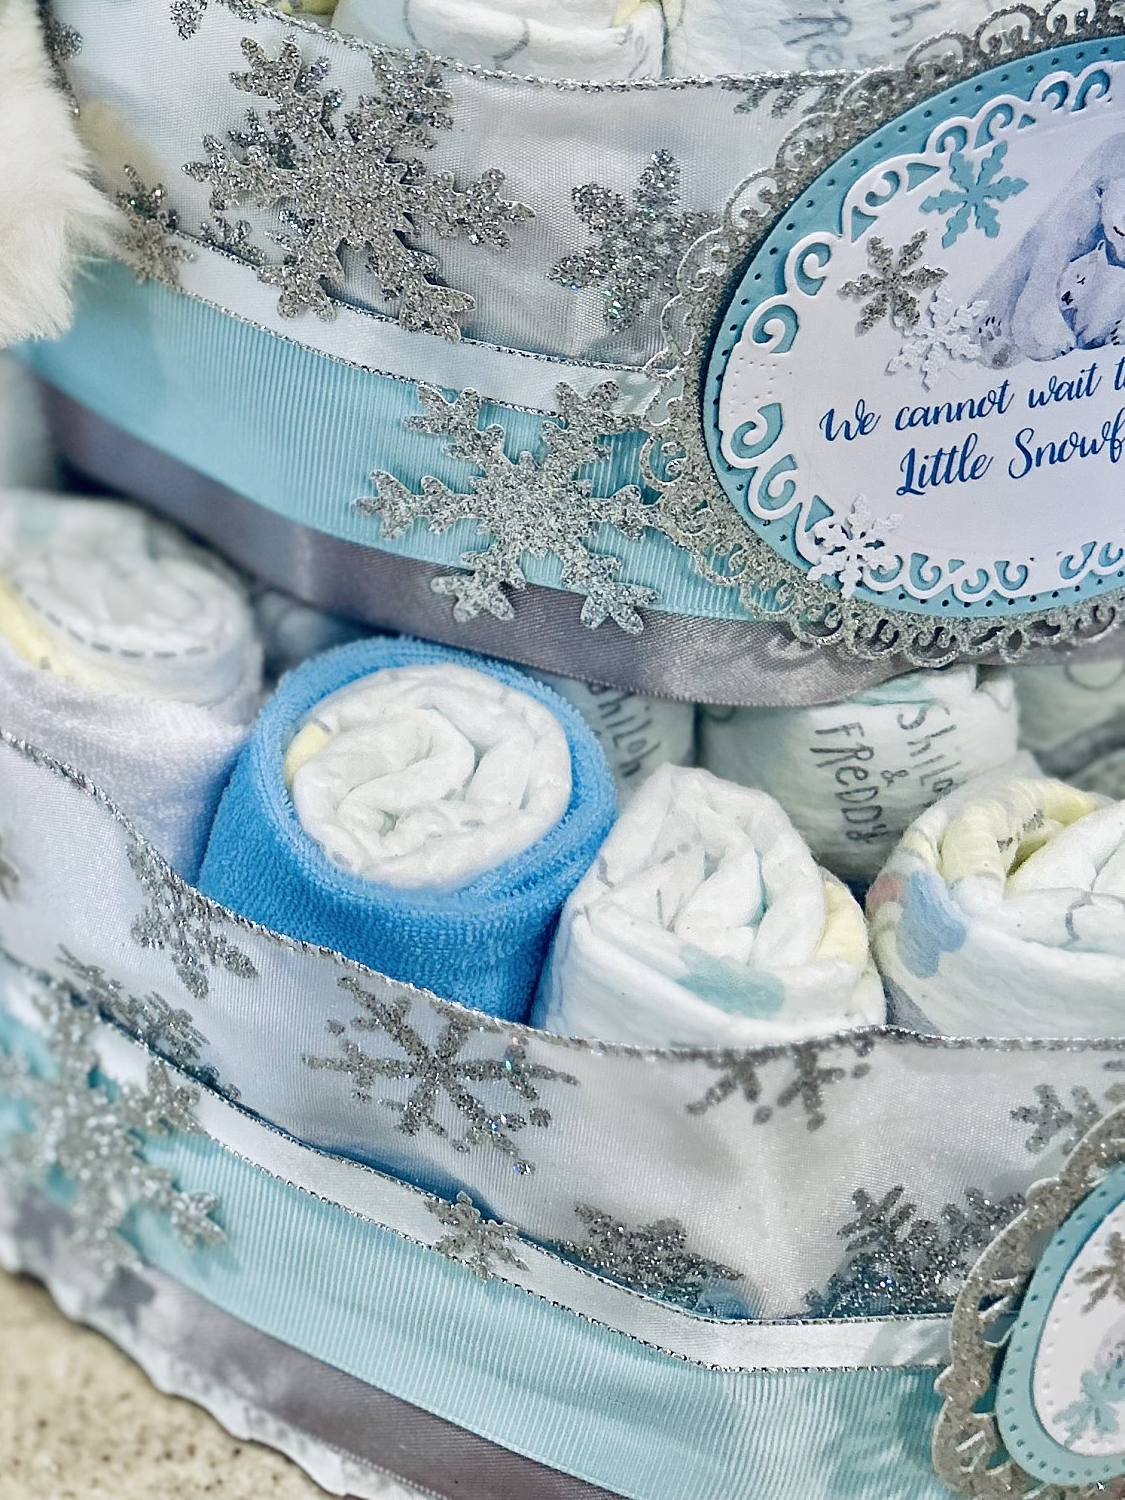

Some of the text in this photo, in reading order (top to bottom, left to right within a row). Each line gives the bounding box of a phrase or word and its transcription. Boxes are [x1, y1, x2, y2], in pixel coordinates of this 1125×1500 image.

[819, 399, 881, 441] We
[895, 379, 1015, 431] cannot
[1028, 362, 1103, 409] wait
[896, 407, 1125, 496] Little Snowf
[880, 759, 910, 788] &
